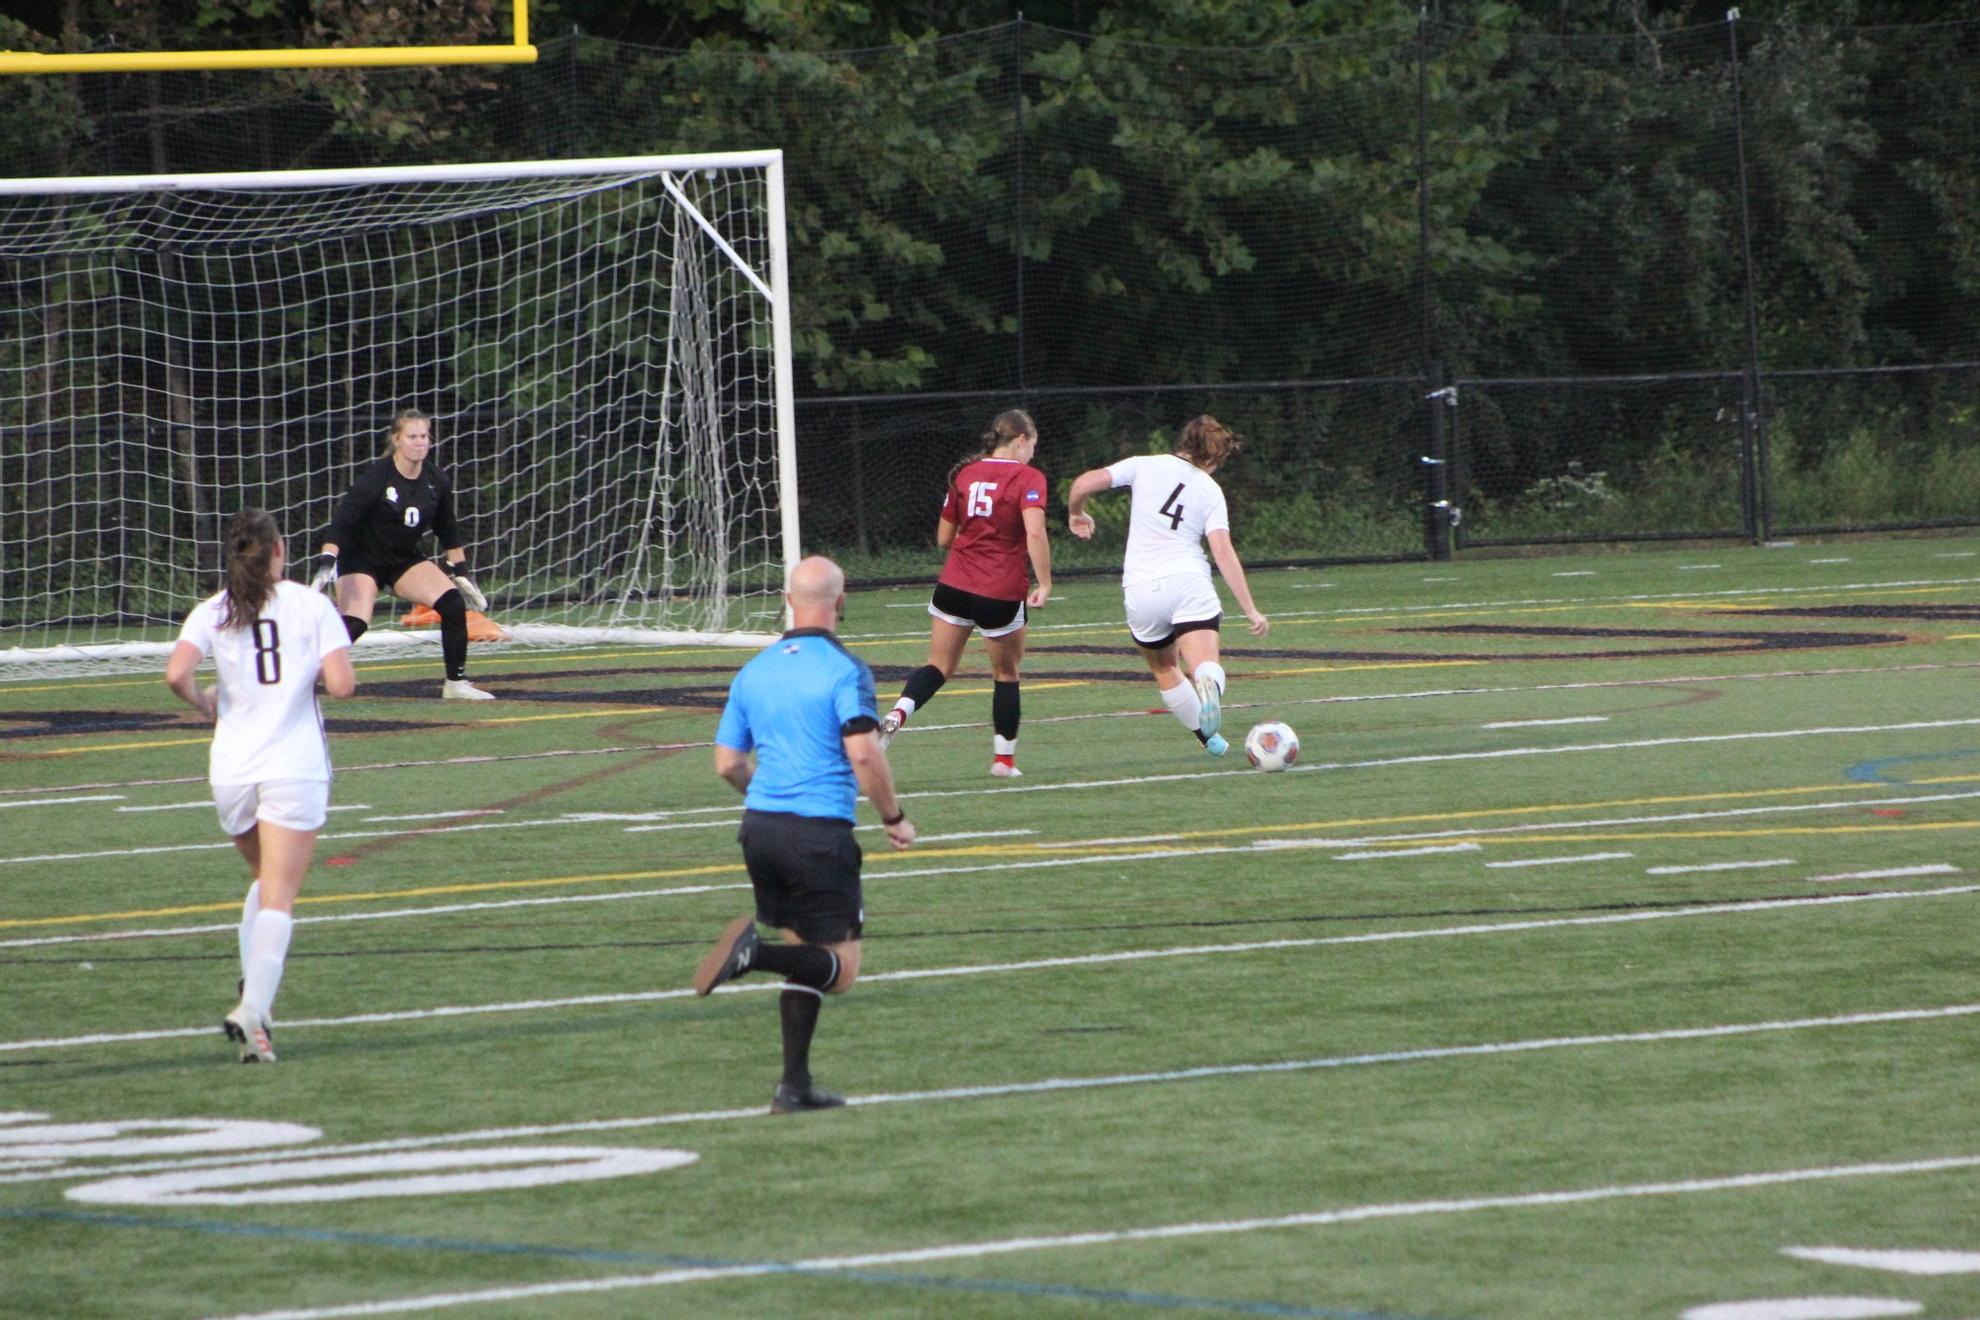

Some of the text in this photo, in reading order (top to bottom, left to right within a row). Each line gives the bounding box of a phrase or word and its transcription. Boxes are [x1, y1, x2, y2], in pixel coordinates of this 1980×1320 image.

[404, 506, 420, 527] 0
[968, 481, 998, 518] 15
[1159, 482, 1186, 530] 4
[253, 619, 280, 684] 8
